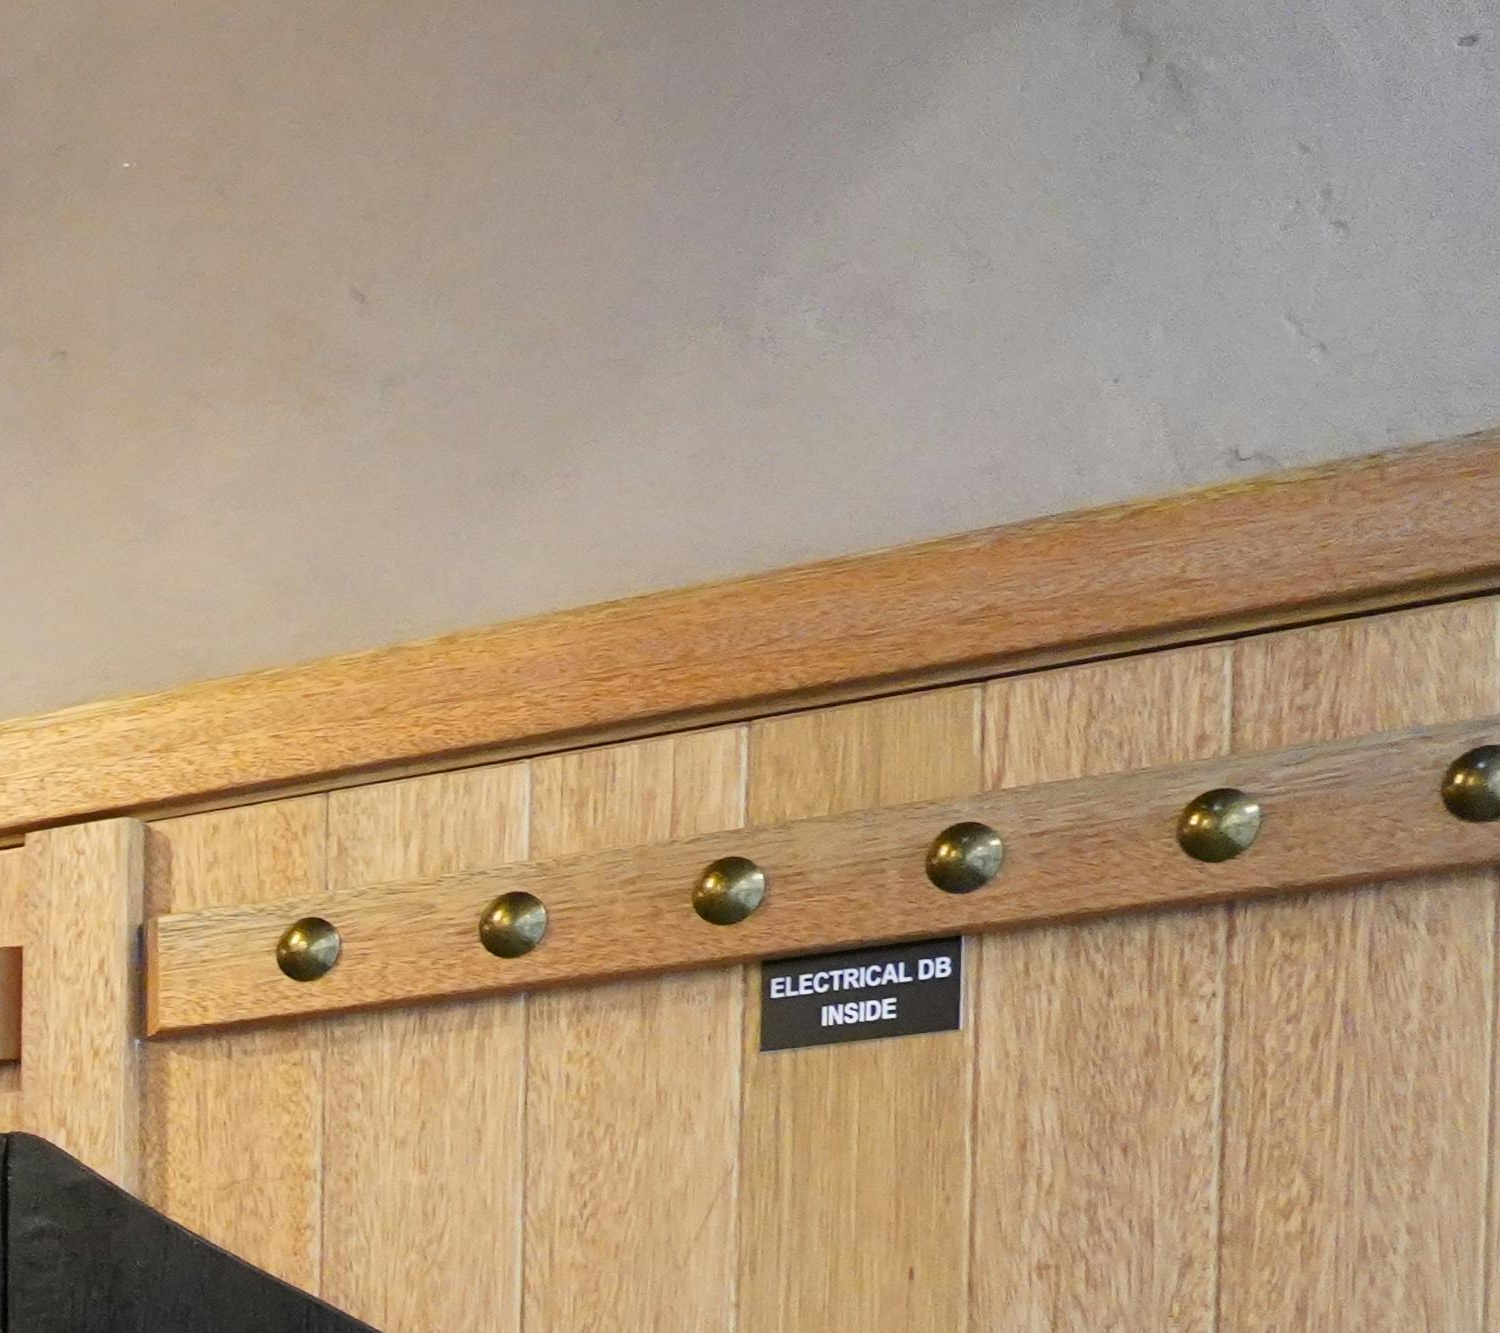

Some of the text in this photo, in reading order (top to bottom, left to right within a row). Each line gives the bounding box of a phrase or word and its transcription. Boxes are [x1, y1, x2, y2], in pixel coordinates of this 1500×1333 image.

[770, 956, 952, 998] ELECTRICAL DB
[821, 998, 897, 1026] INSIDE
